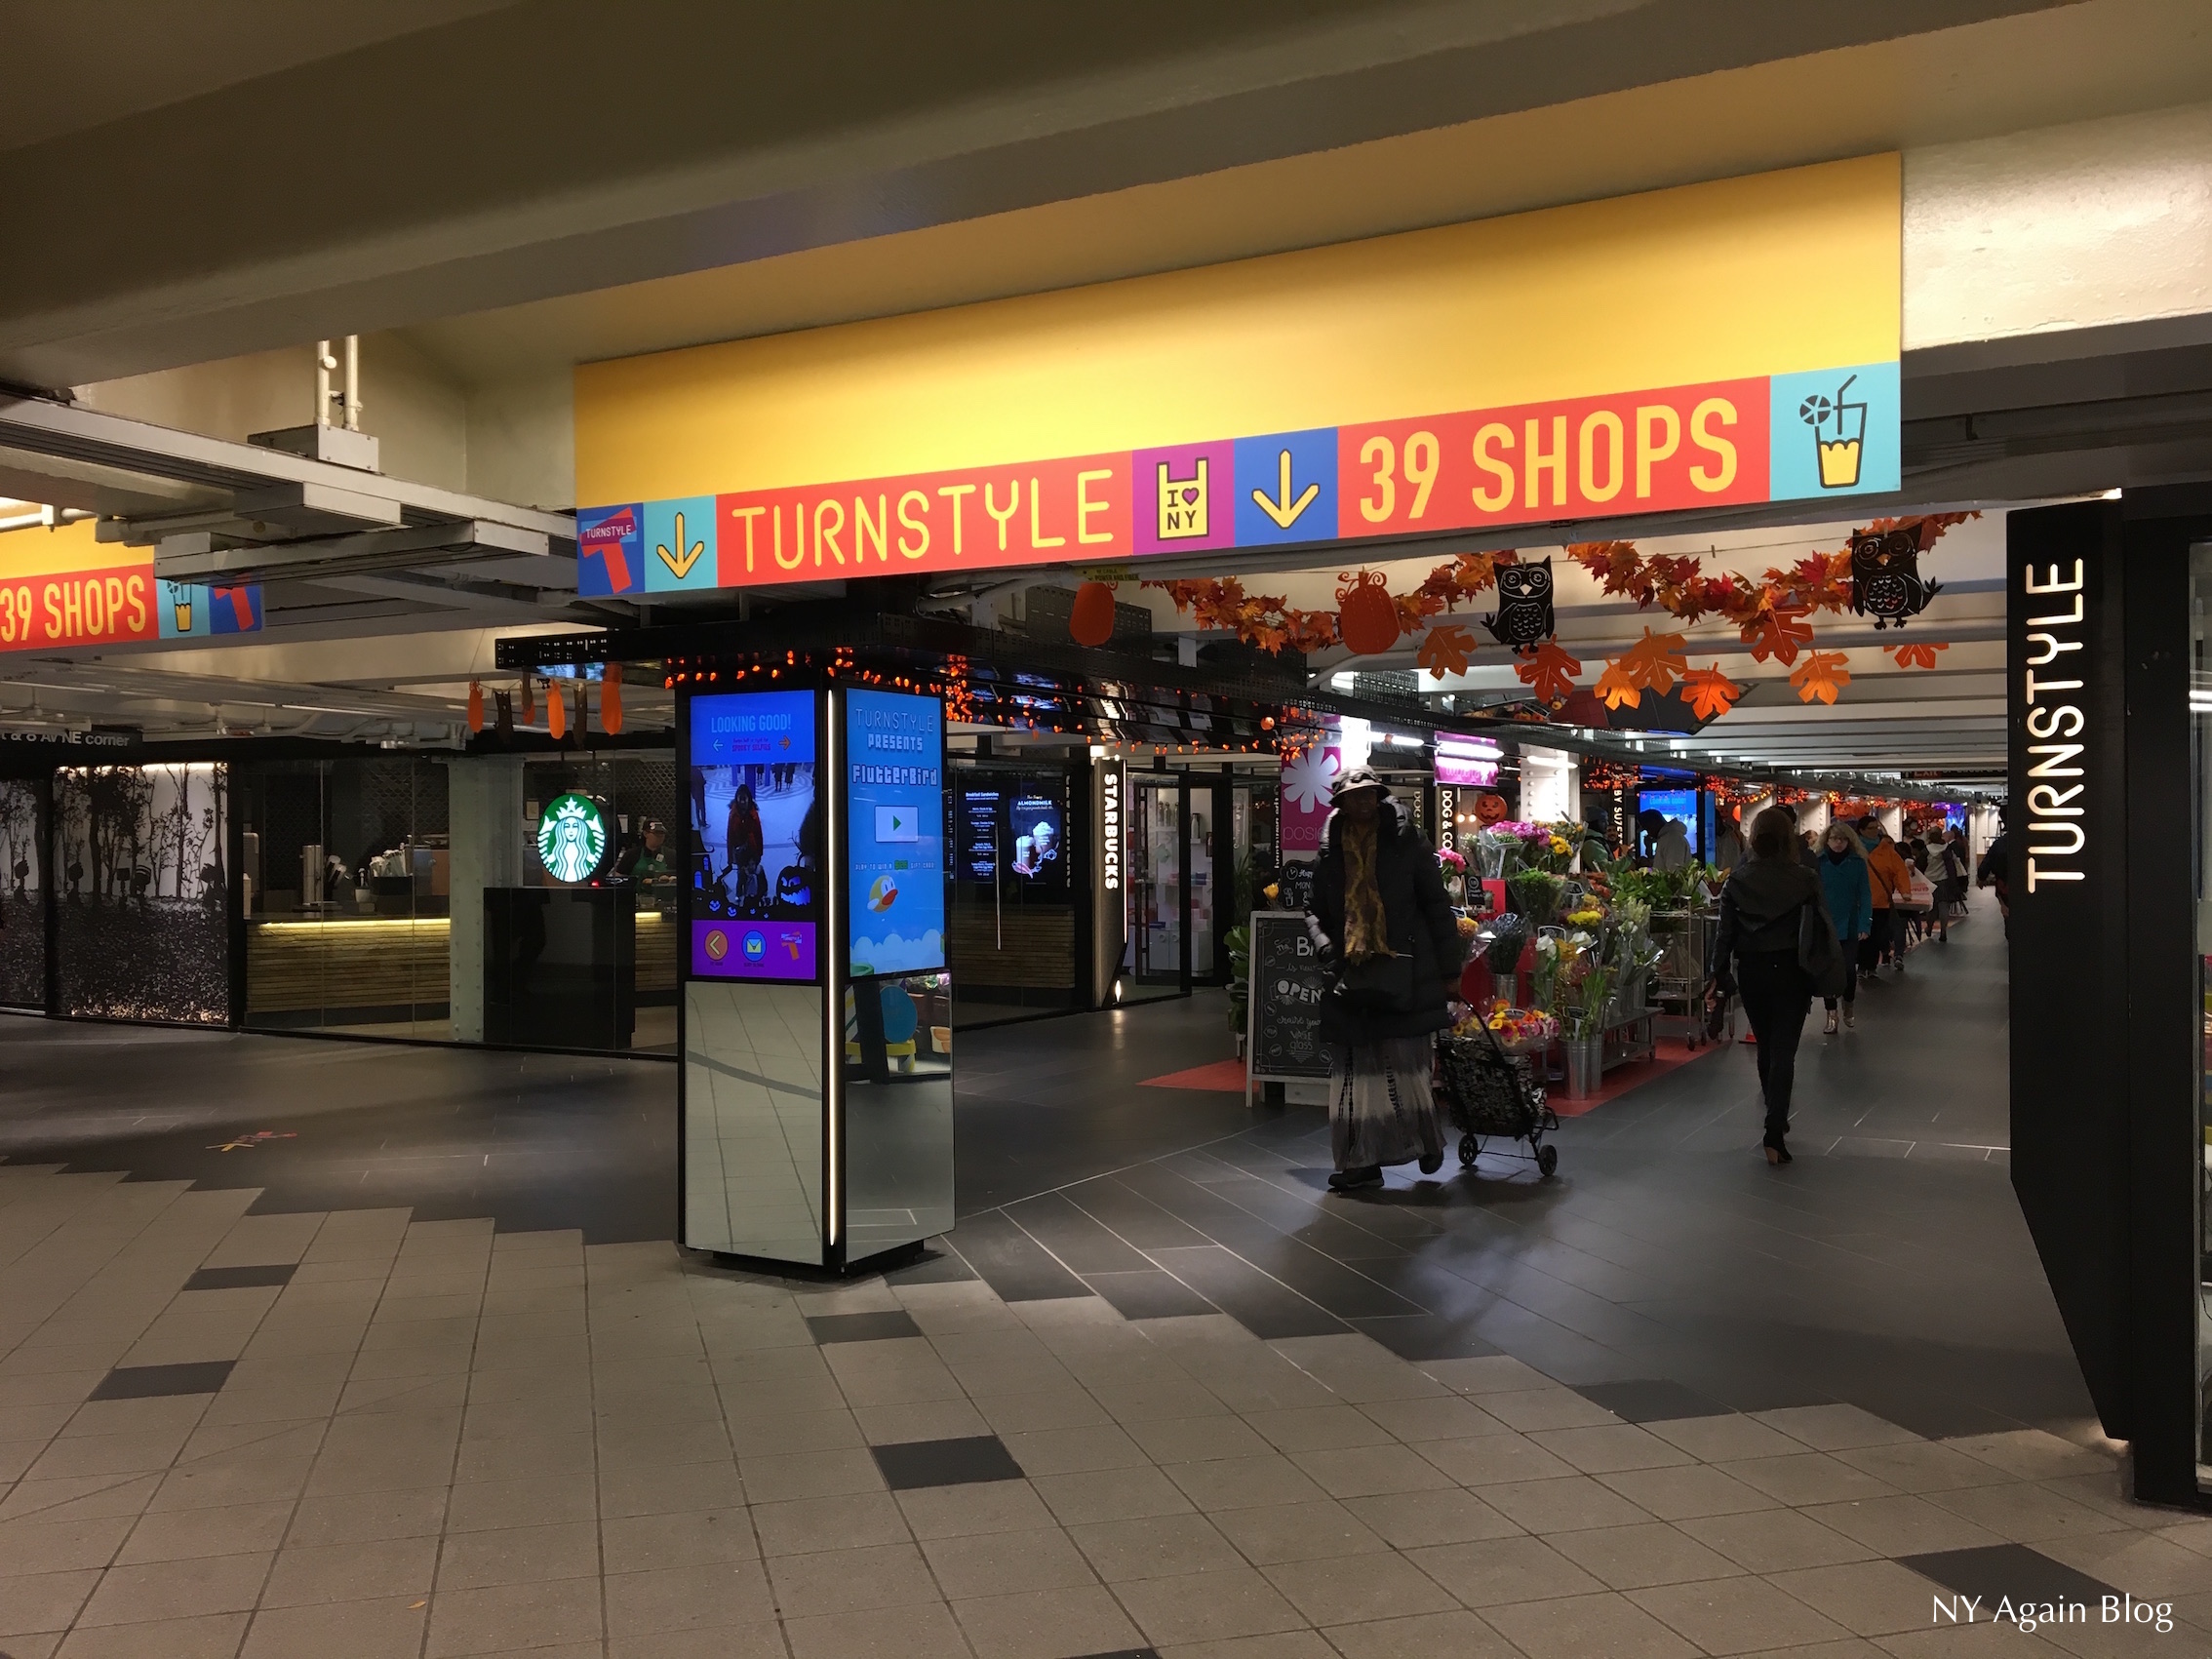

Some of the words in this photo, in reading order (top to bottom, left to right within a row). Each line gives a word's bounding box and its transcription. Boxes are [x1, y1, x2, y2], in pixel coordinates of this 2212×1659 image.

[1360, 430, 1440, 522] 39
[1472, 397, 1738, 512] SHOPS
[1166, 490, 1178, 507] I
[731, 468, 1114, 573] TURNSTYLE
[1166, 510, 1198, 531] NY
[586, 524, 632, 539] TURNSTYLE
[0, 585, 32, 643] 39
[44, 574, 145, 639] SHOPS
[711, 716, 756, 733] LOOKING
[759, 714, 791, 731] GOOD!
[855, 708, 934, 732] TURNSTYLE
[2026, 558, 2085, 894] TURNSTYLE
[85, 733, 130, 747] corner
[867, 733, 924, 752] PRESENTS
[852, 765, 938, 786] FlutterBird
[1442, 790, 1453, 818] DOG
[1614, 790, 1623, 803] BY
[1104, 773, 1118, 889] STARBUCKS
[1442, 820, 1453, 830] &
[1442, 831, 1453, 850] CO
[1277, 979, 1322, 1004] OPEN
